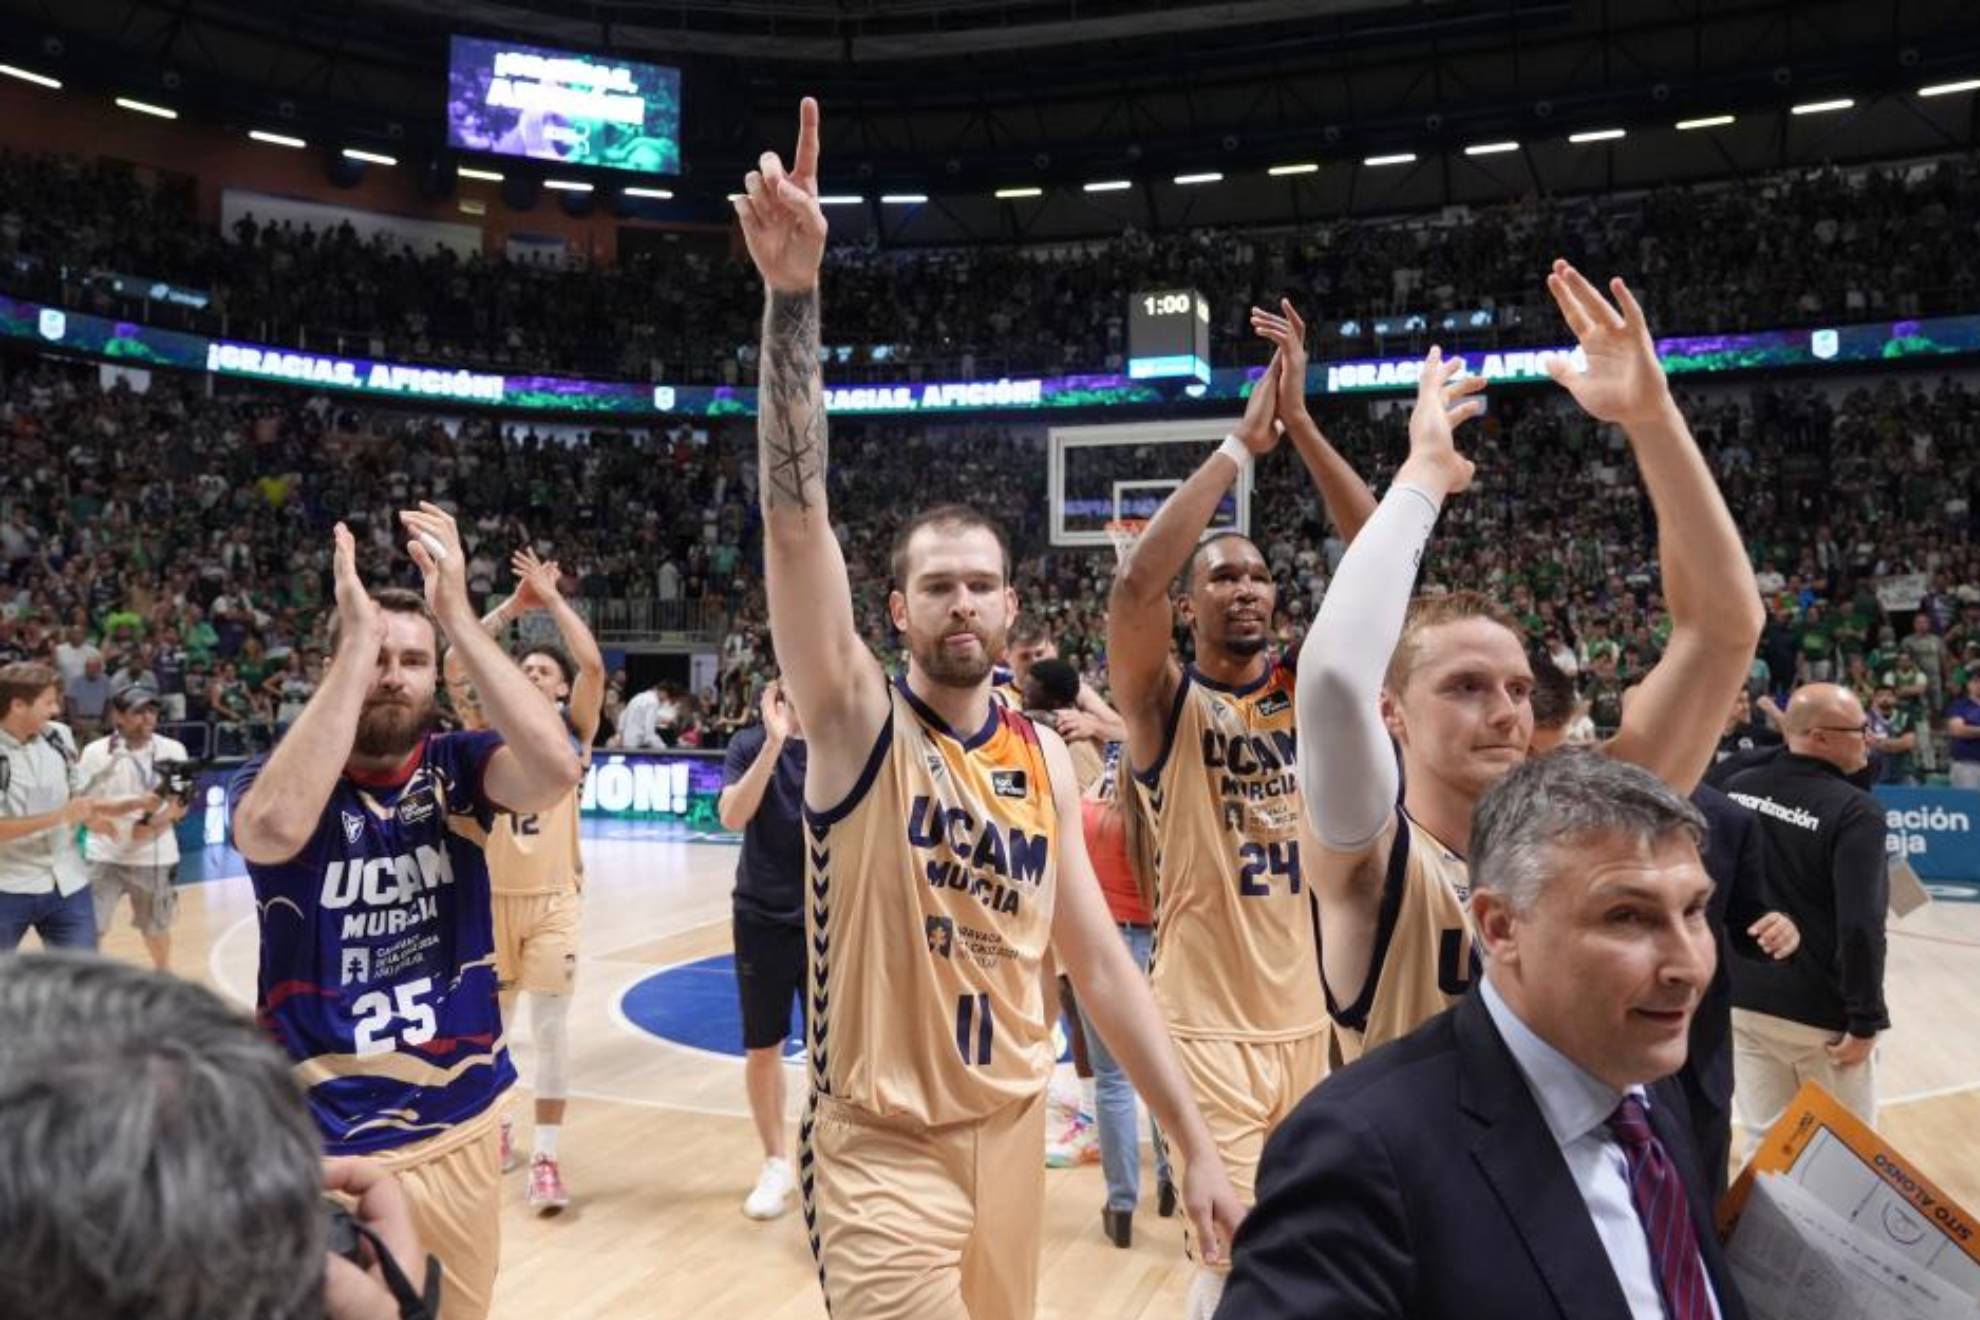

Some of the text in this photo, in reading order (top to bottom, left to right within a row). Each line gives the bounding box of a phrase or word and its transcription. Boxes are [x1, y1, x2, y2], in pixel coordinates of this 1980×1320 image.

[1143, 293, 1190, 316] 1:00
[206, 343, 505, 405] ¡GRACIAS, AFICIÓN!
[907, 795, 1049, 887] UCAM
[1886, 806, 1970, 832] ación
[319, 842, 455, 910] UCAM
[1239, 840, 1300, 897] 24
[351, 976, 439, 1059] 25
[956, 992, 994, 1066] 11
[1874, 1153, 1974, 1241] SITO ALONSO
